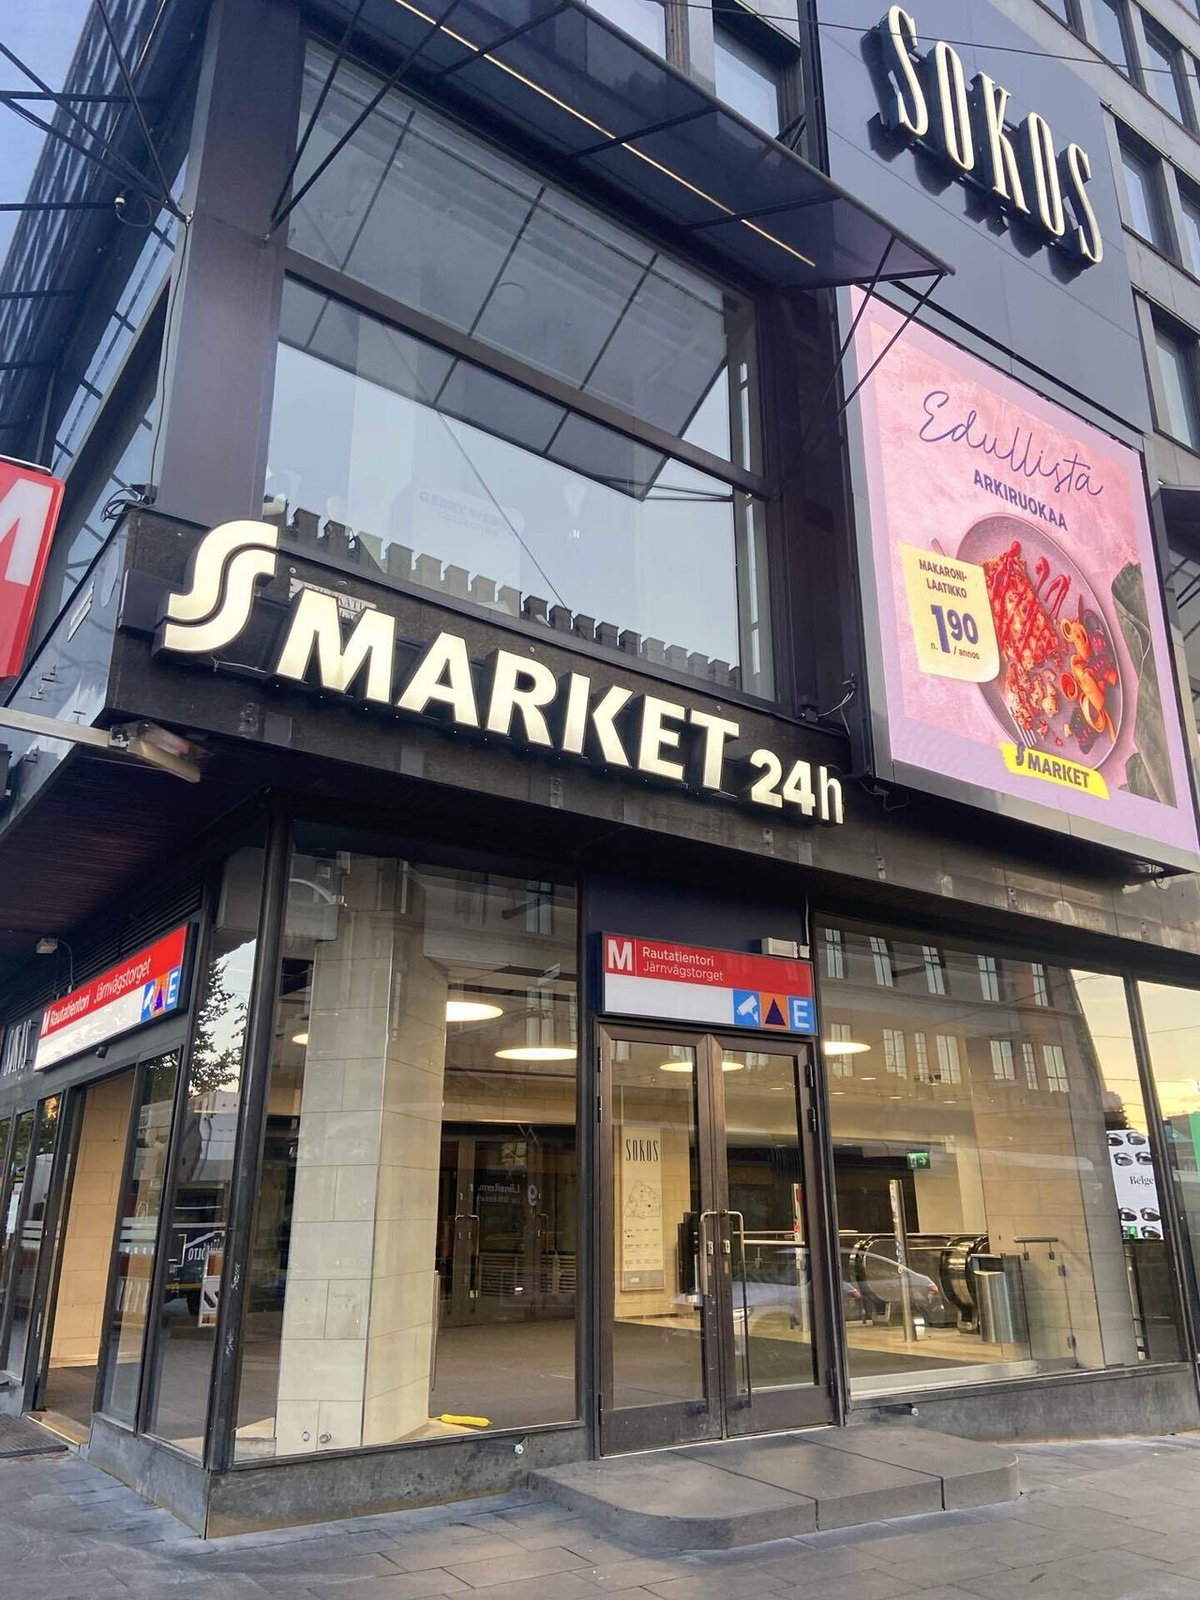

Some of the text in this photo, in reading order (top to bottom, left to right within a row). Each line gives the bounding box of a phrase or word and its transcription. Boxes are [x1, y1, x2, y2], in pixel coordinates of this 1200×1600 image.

[872, 5, 1103, 264] SOKOS
[919, 390, 1104, 496] Edullista
[973, 469, 1069, 531] ARKIRUOKAA
[918, 559, 968, 582] MAKARONI-
[926, 578, 968, 599] LAATIKKO
[275, 588, 741, 792] MARKET
[748, 748, 846, 825] 24h
[1027, 752, 1090, 789] MARKET
[607, 939, 714, 972] M Rautatientori
[643, 961, 724, 982] Järnvägstorget
[50, 990, 91, 1027] Rautatientori
[93, 956, 152, 1004] Järnvägstorget
[167, 970, 180, 1005] E
[793, 999, 810, 1029] E
[625, 1138, 660, 1163] SOKOS
